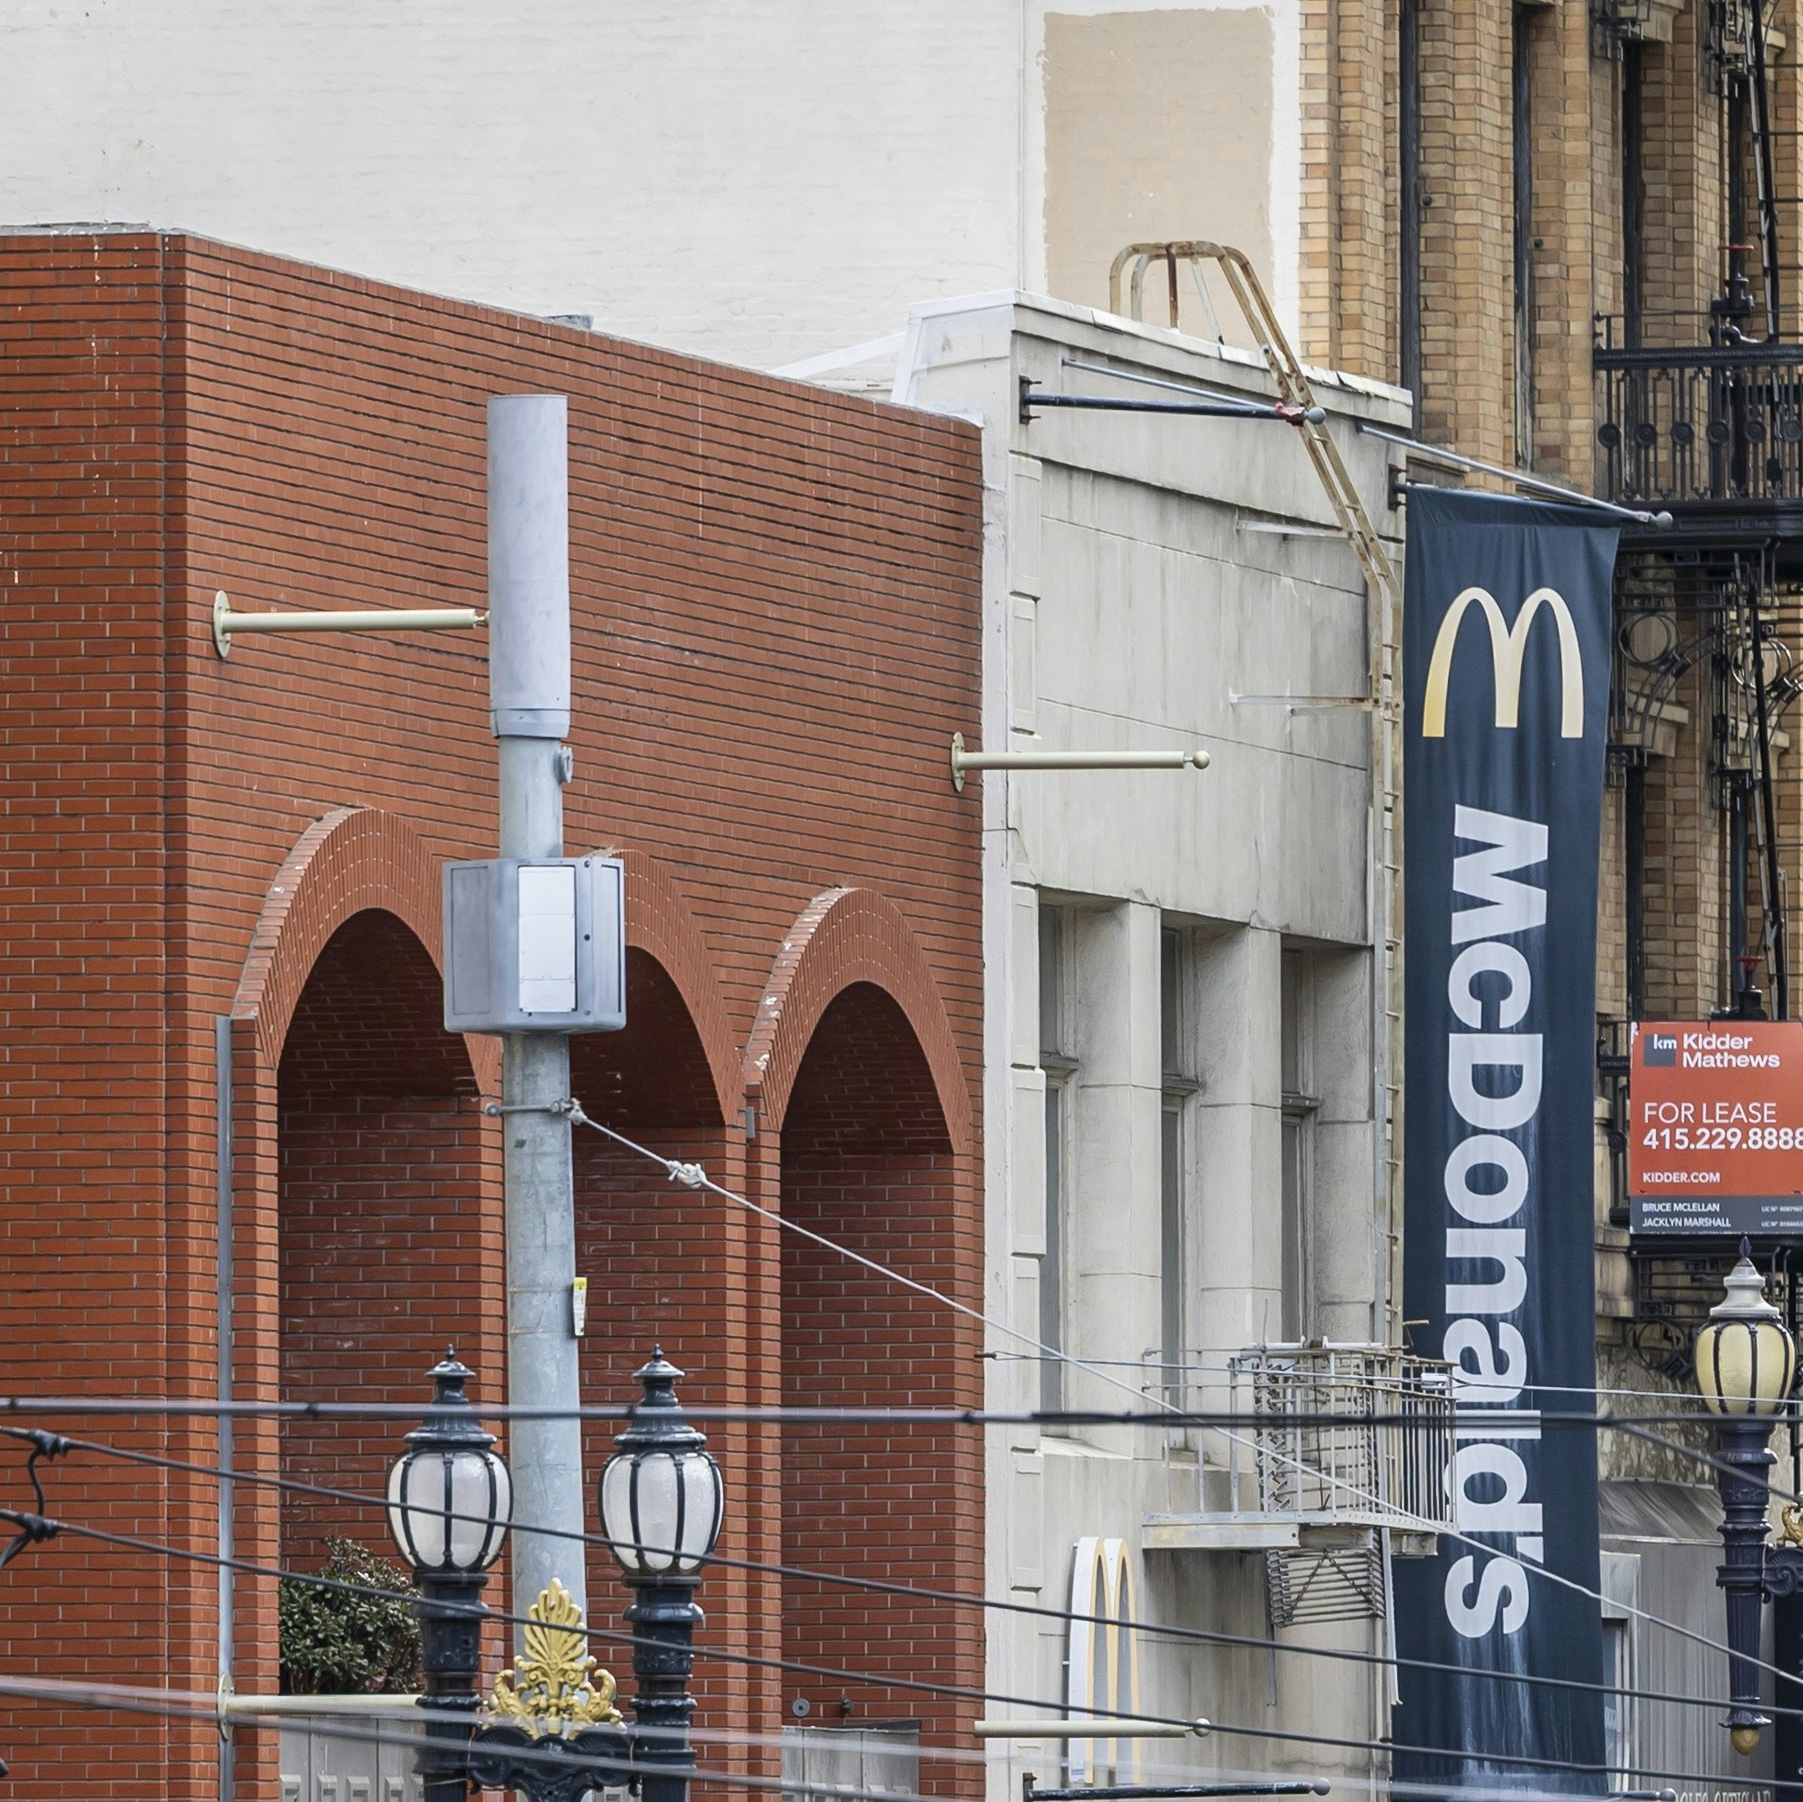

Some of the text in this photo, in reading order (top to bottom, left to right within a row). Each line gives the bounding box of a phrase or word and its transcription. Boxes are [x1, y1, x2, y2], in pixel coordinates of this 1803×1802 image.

[1653, 1033, 1677, 1050] km
[1682, 1033, 1753, 1050] Kidder
[1682, 1052, 1781, 1068] Mathews
[1644, 1102, 1777, 1124] FOR LEASE
[1642, 1172, 1721, 1184] KIDDER.COM
[1642, 1203, 1720, 1213] BRUCE MCLELLAN
[1443, 803, 1550, 1638] McDonald's
[1642, 1217, 1731, 1229] JACKLYN MARSHALL
